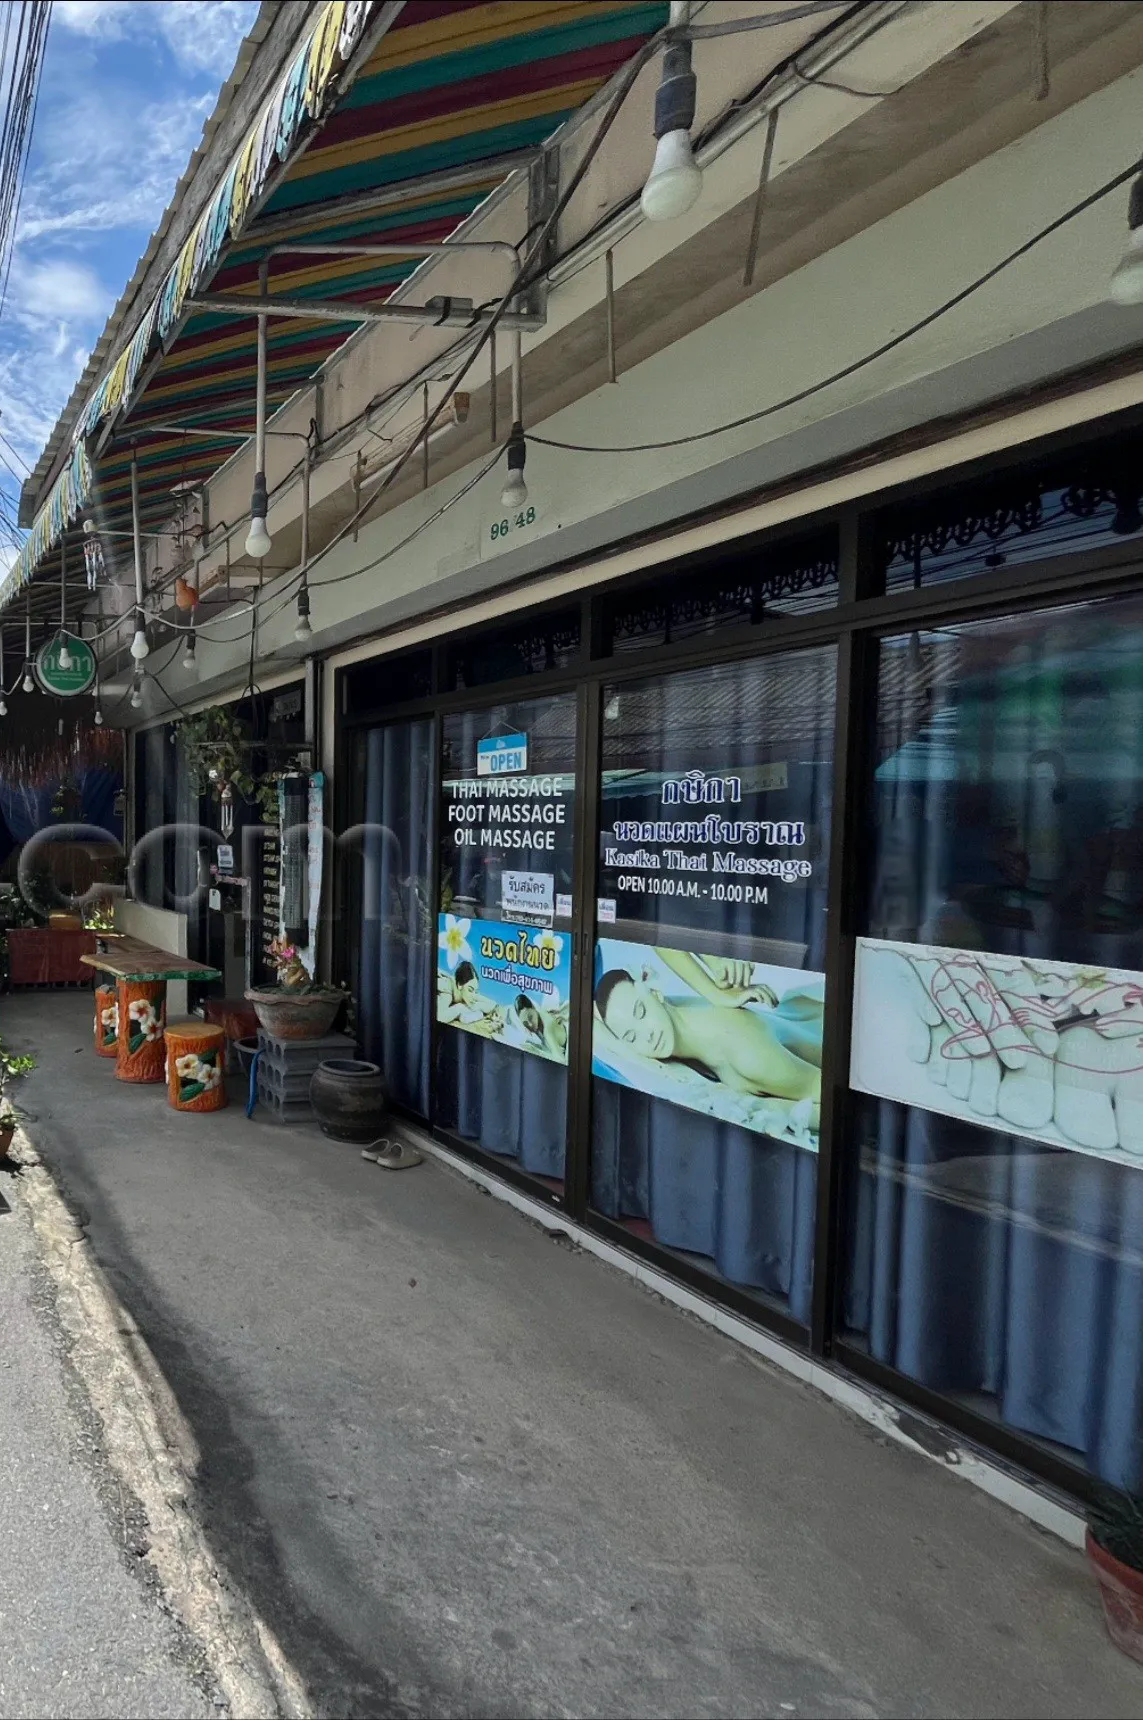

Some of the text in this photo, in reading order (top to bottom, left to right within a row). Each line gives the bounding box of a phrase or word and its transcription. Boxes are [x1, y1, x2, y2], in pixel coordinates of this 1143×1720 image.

[490, 751, 522, 772] OPEN
[451, 777, 564, 799] THAI MASSAGE
[661, 769, 742, 804] กษิกา
[448, 804, 566, 824] FOOT MASSAGE
[454, 828, 556, 850] OIL MASSAGE
[613, 814, 806, 846] นวดแผนโบราณ
[605, 847, 812, 883] Kasika Thai Massage
[507, 875, 546, 894] รับสมัคร
[617, 875, 646, 893] OPEN
[647, 877, 675, 896] 10.00
[676, 880, 701, 898] A.M.
[710, 883, 742, 902] 10.00
[744, 886, 768, 905] P.M
[480, 929, 556, 972] นวดไทย
[480, 964, 554, 994] นวดเพื่อสุขภาพ
